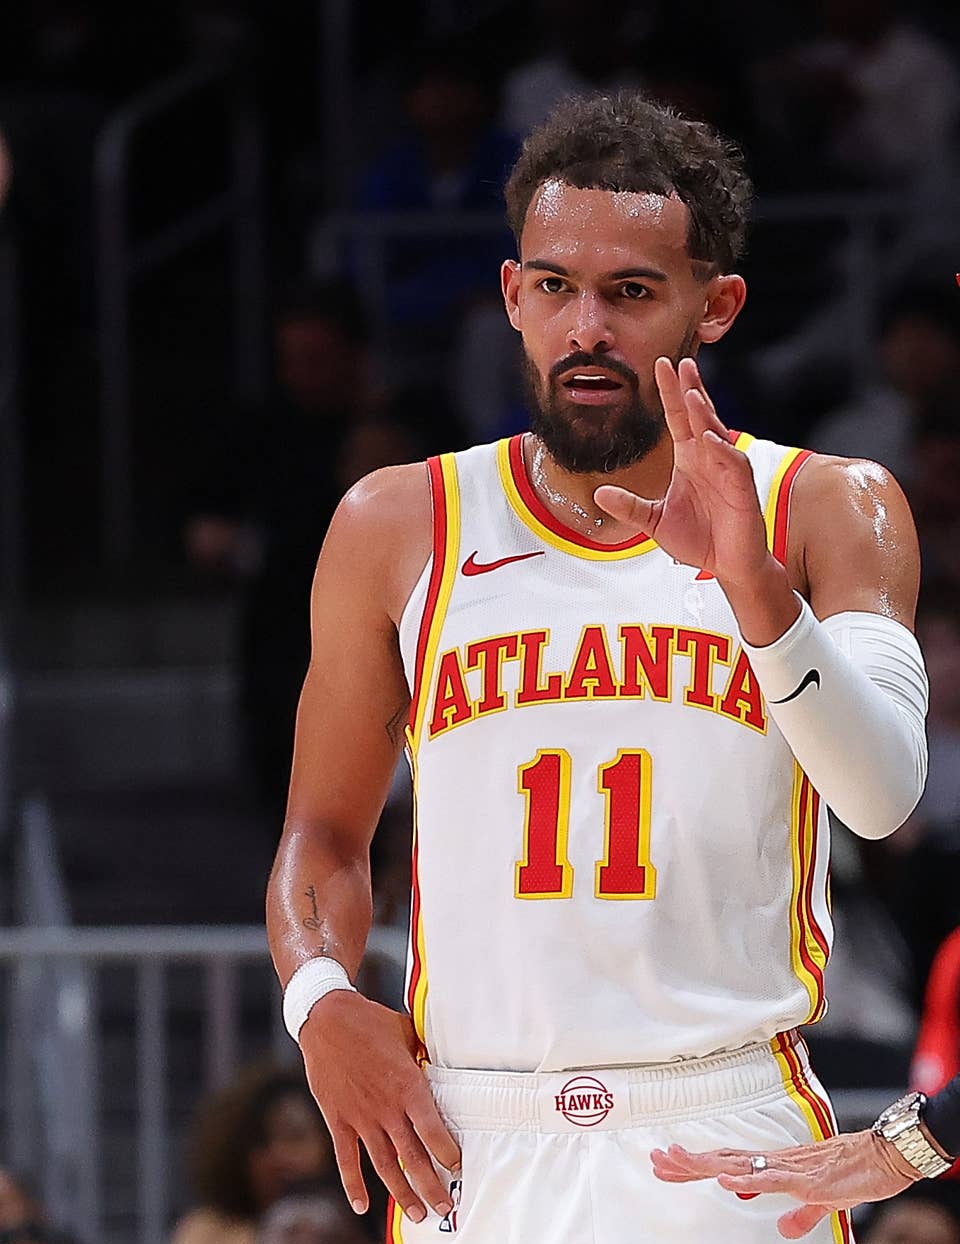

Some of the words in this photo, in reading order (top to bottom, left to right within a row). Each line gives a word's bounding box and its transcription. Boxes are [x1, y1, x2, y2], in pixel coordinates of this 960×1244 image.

[429, 624, 768, 741] ATLANTA
[514, 748, 657, 900] 11
[554, 1093, 614, 1111] HAWKS
